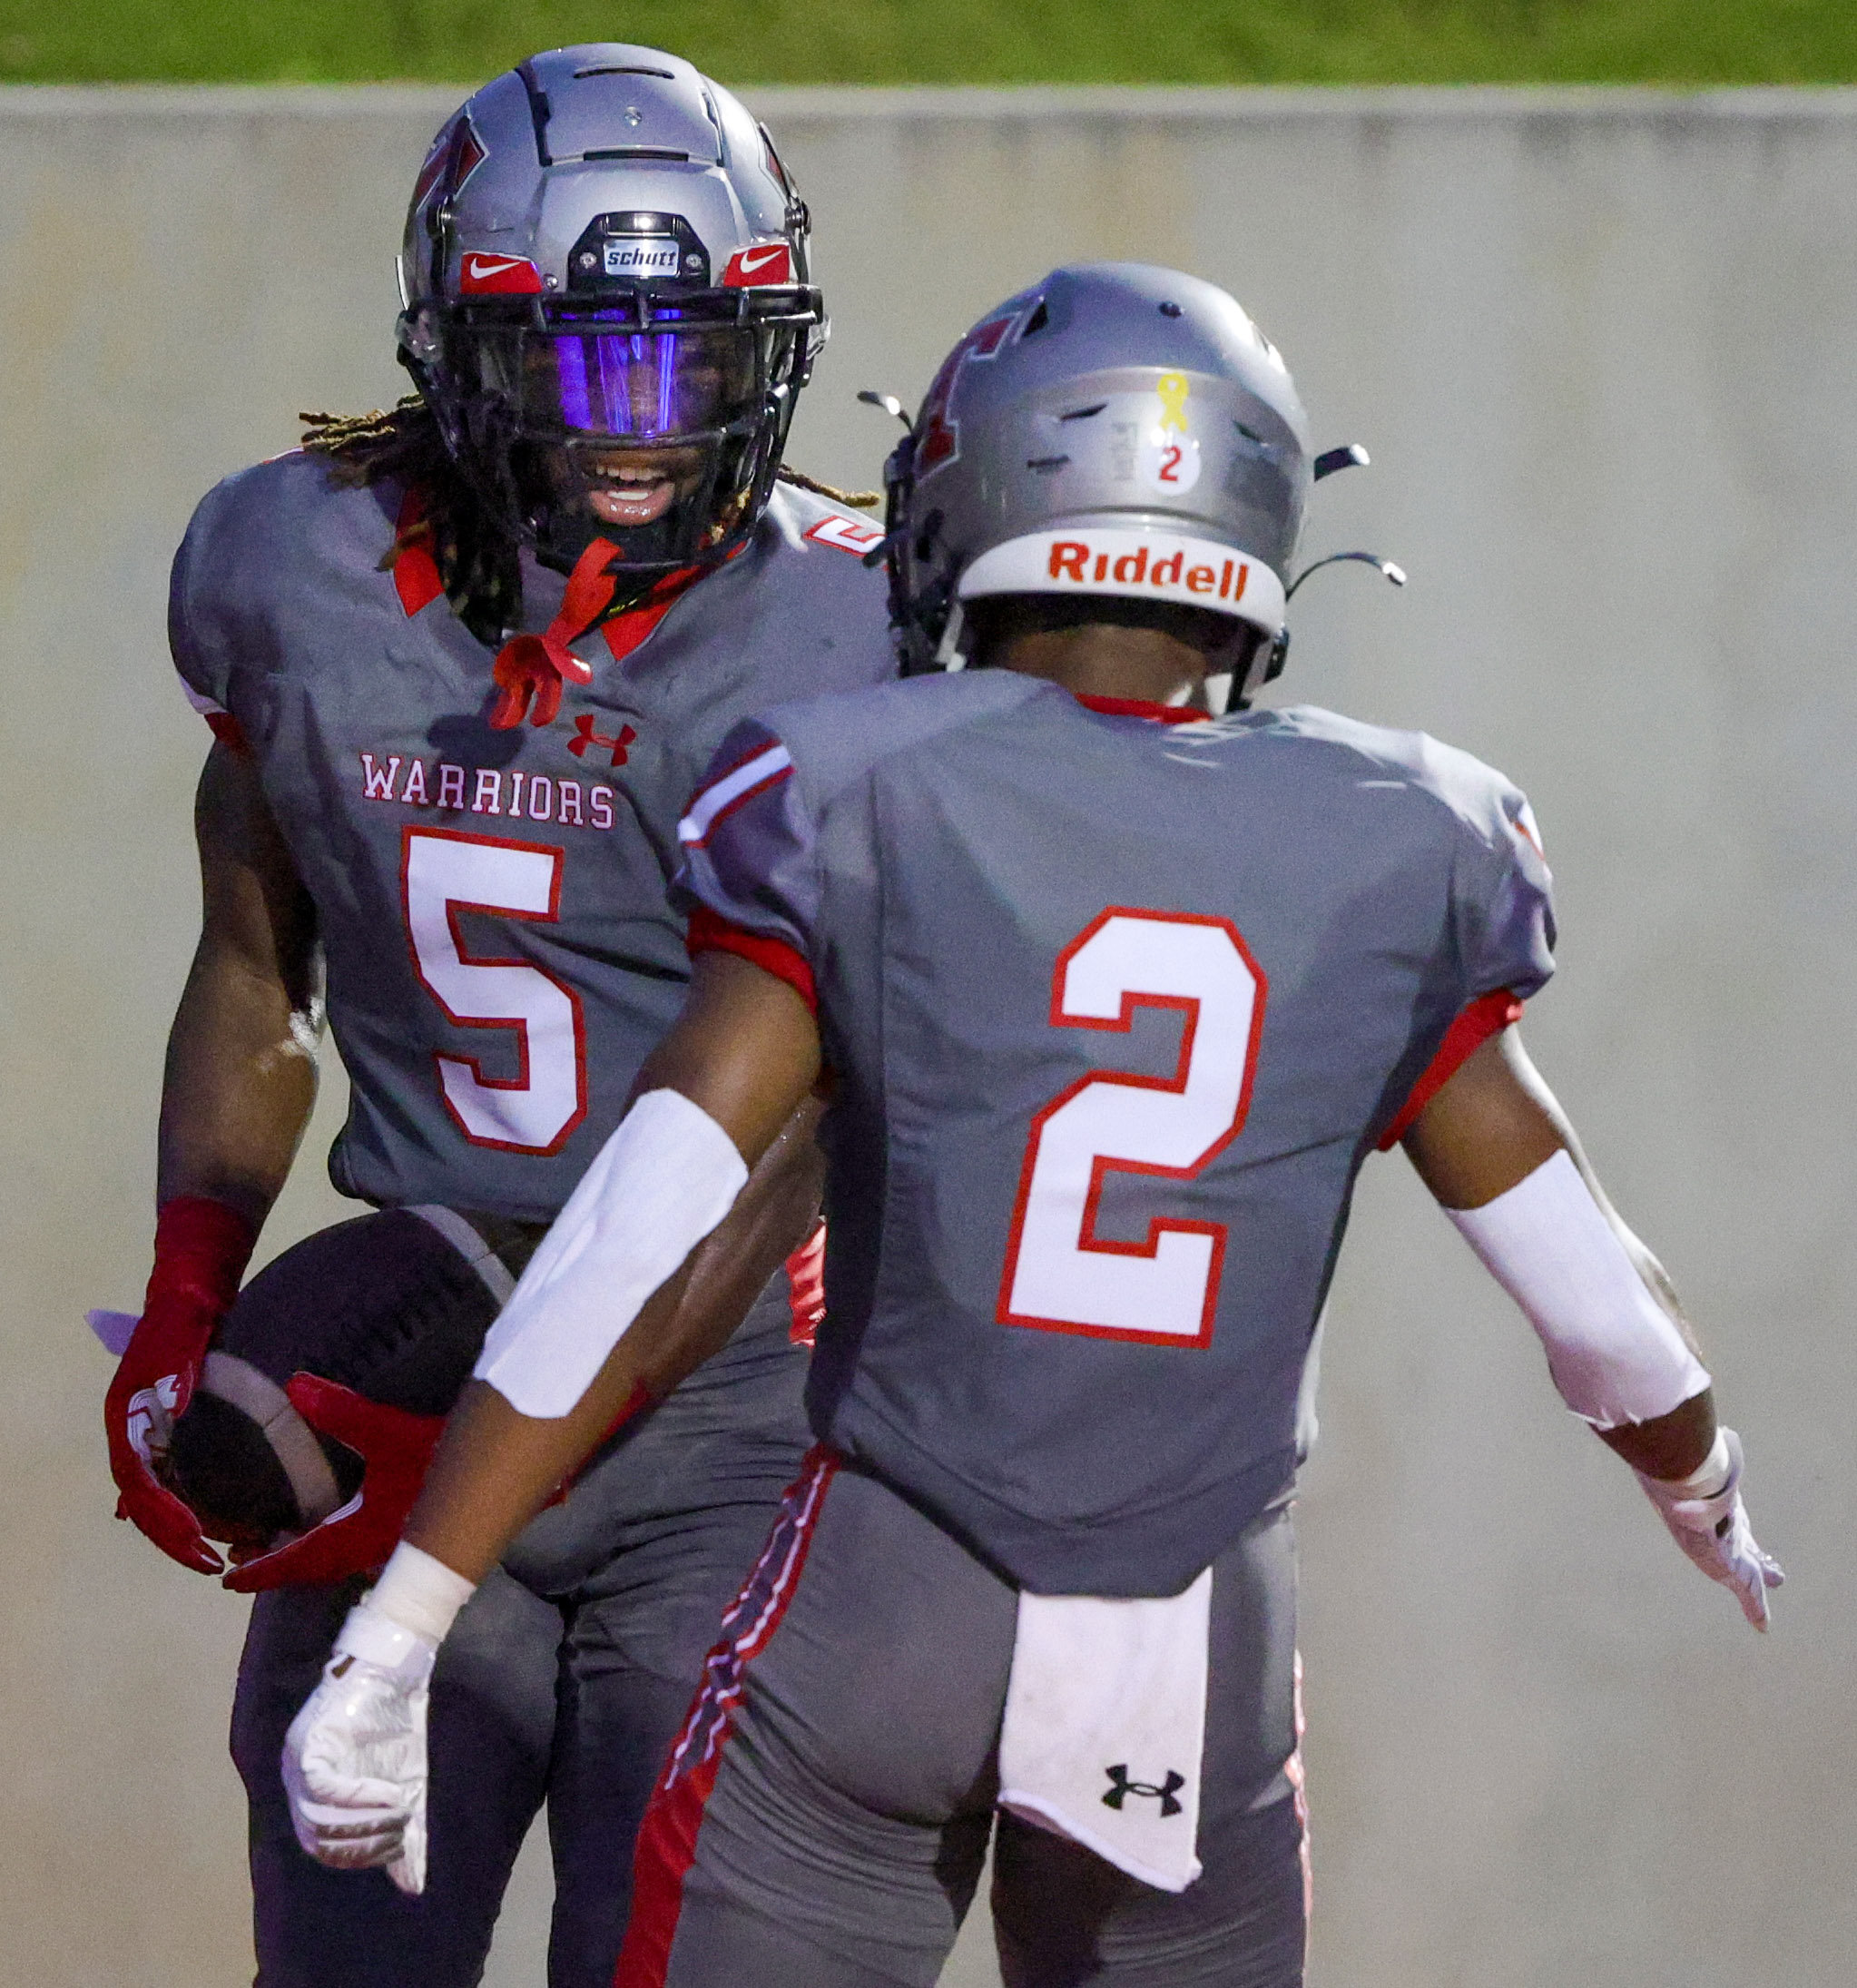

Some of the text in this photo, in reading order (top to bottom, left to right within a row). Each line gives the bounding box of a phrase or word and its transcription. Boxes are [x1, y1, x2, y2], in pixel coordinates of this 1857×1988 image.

[607, 247, 676, 266] schutt
[1159, 446, 1182, 481] 2
[1048, 541, 1249, 602] Riddell
[361, 753, 615, 830] WARRIORS
[401, 824, 588, 1157] 5
[997, 905, 1267, 1350] 2
